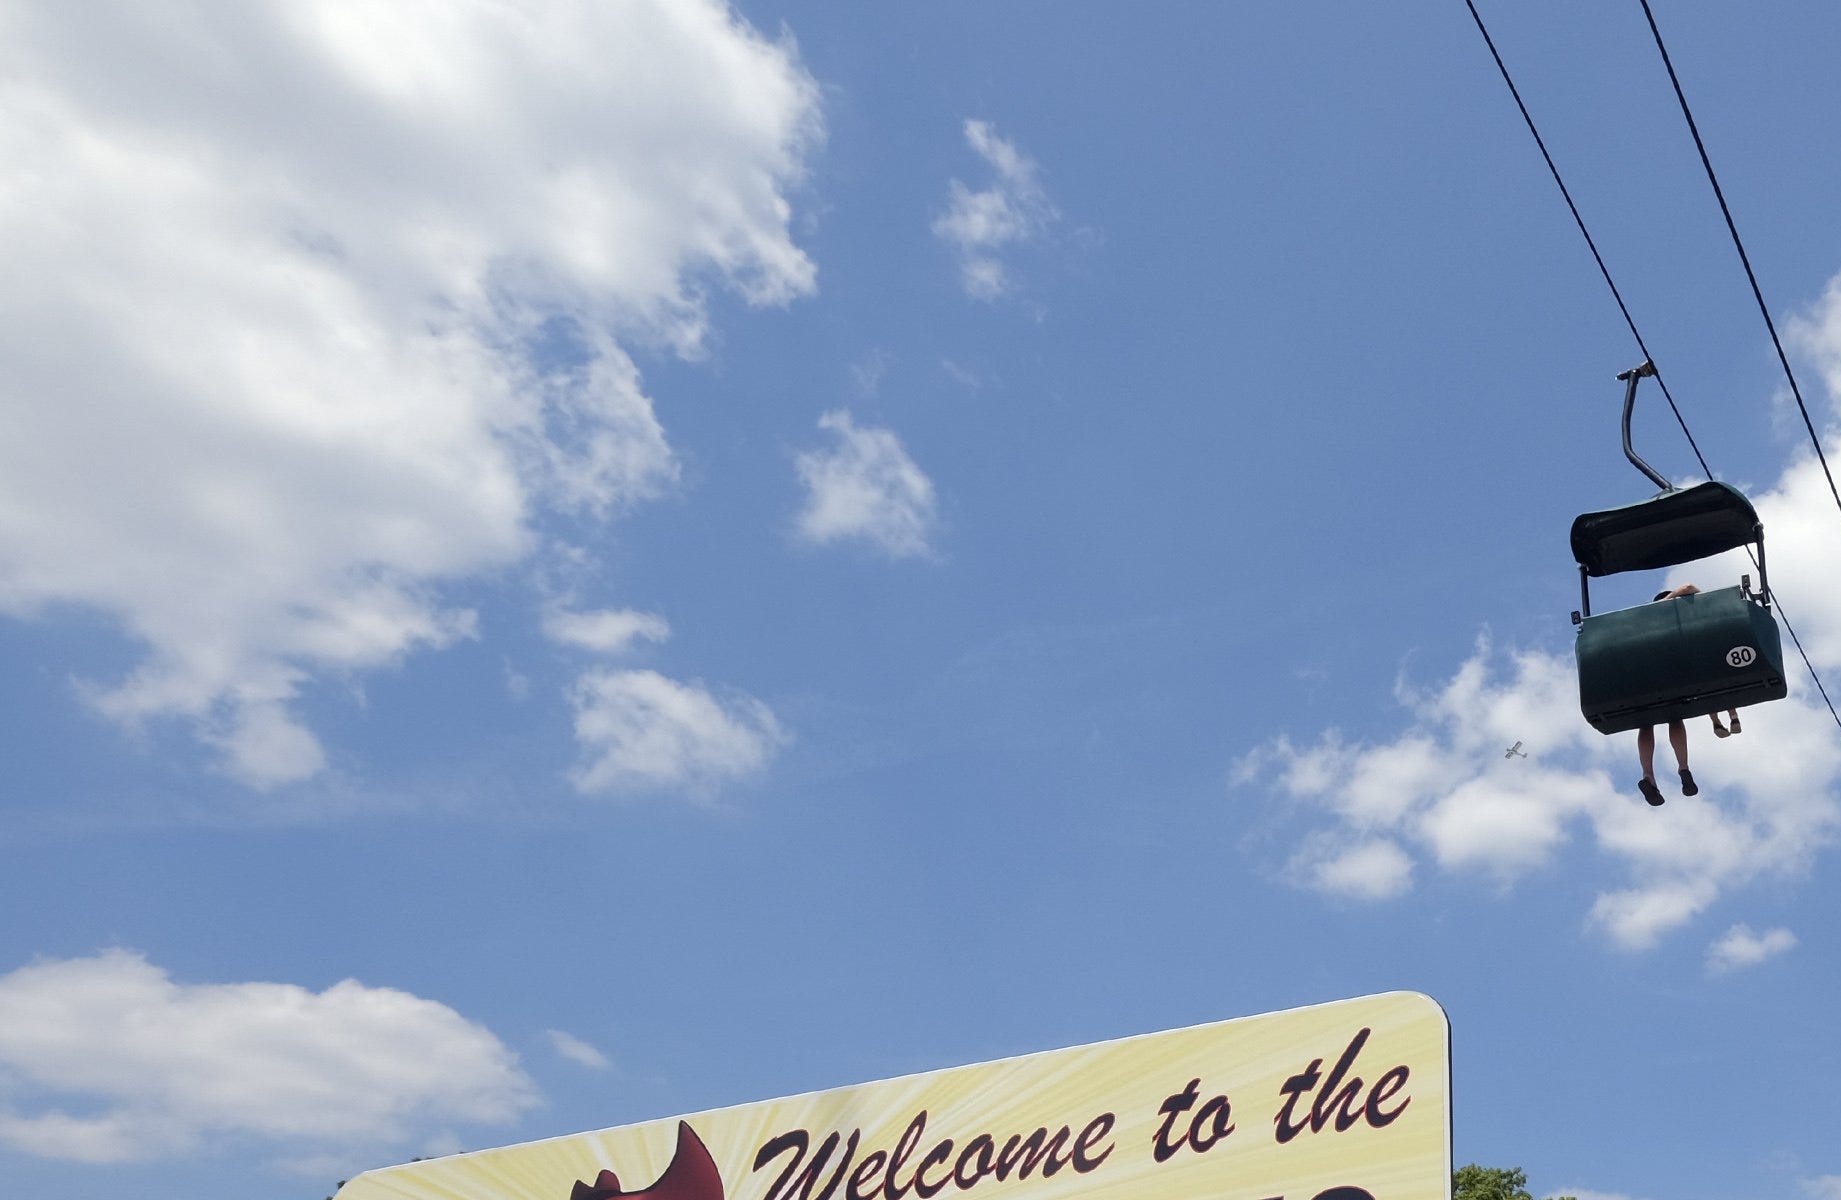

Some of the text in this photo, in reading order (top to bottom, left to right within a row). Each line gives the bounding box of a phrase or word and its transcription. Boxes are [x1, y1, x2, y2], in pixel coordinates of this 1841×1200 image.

[1731, 648, 1752, 666] 80
[1152, 1078, 1235, 1163] to
[1273, 1027, 1411, 1144] the
